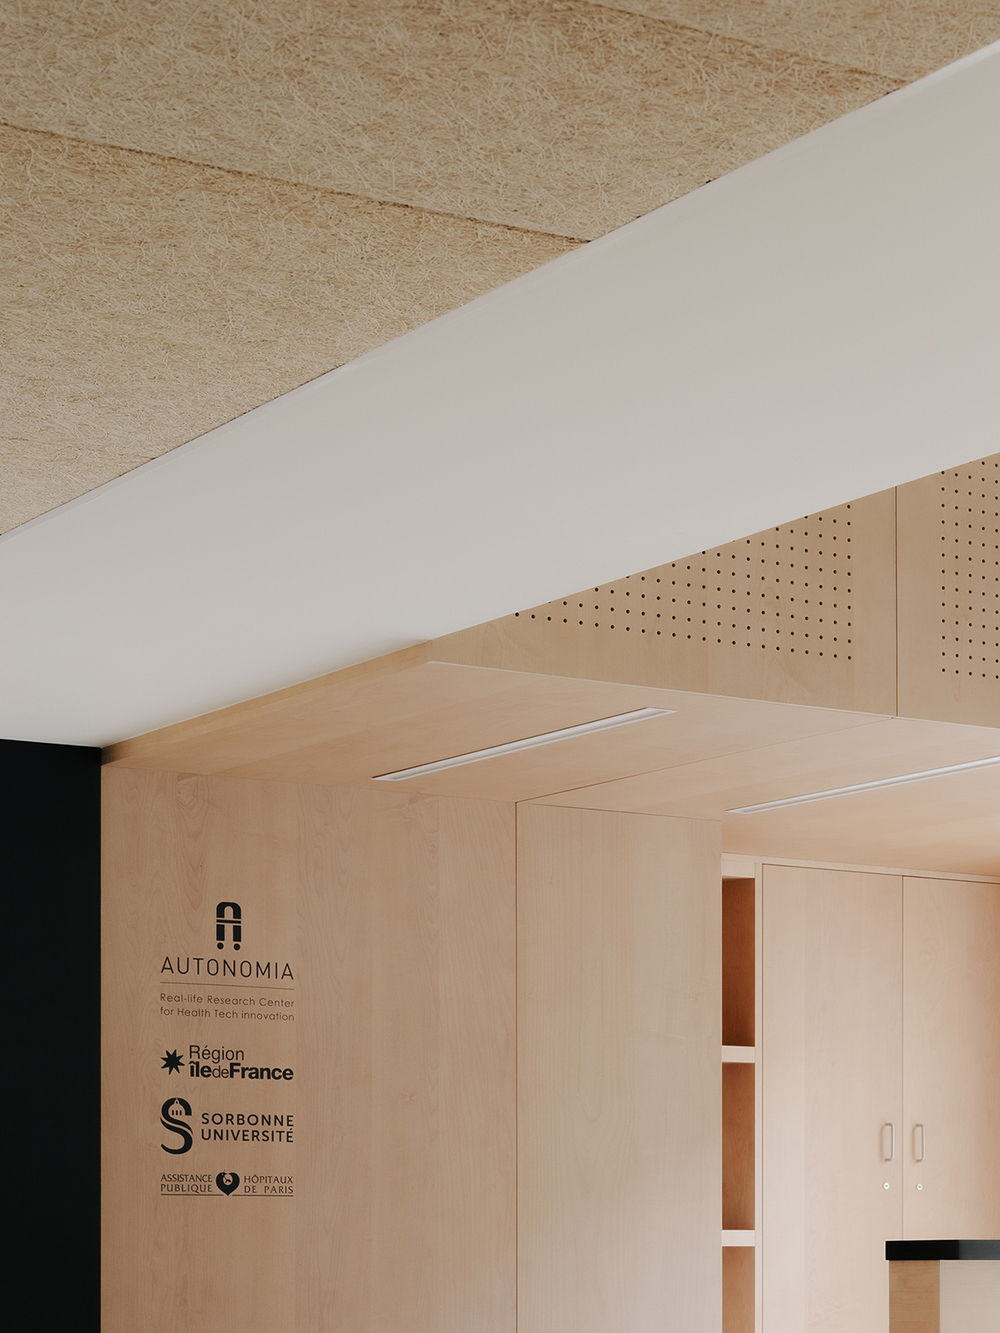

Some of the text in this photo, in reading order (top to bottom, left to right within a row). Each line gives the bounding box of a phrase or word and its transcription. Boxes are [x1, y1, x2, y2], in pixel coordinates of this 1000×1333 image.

[160, 956, 294, 980] AUTONOMIA
[160, 992, 295, 1008] Real-life Research Center
[160, 1006, 295, 1021] for Health Tech innovation
[189, 1044, 245, 1064] Région
[201, 1112, 294, 1127] SORBONNE
[201, 1128, 294, 1143] UNIVERSITÉ
[160, 1174, 213, 1183] ASSISTANCE
[243, 1174, 294, 1184] HÔPITAUX
[160, 1183, 213, 1194] PUBLIQUE
[243, 1185, 294, 1194] DE PARIS
